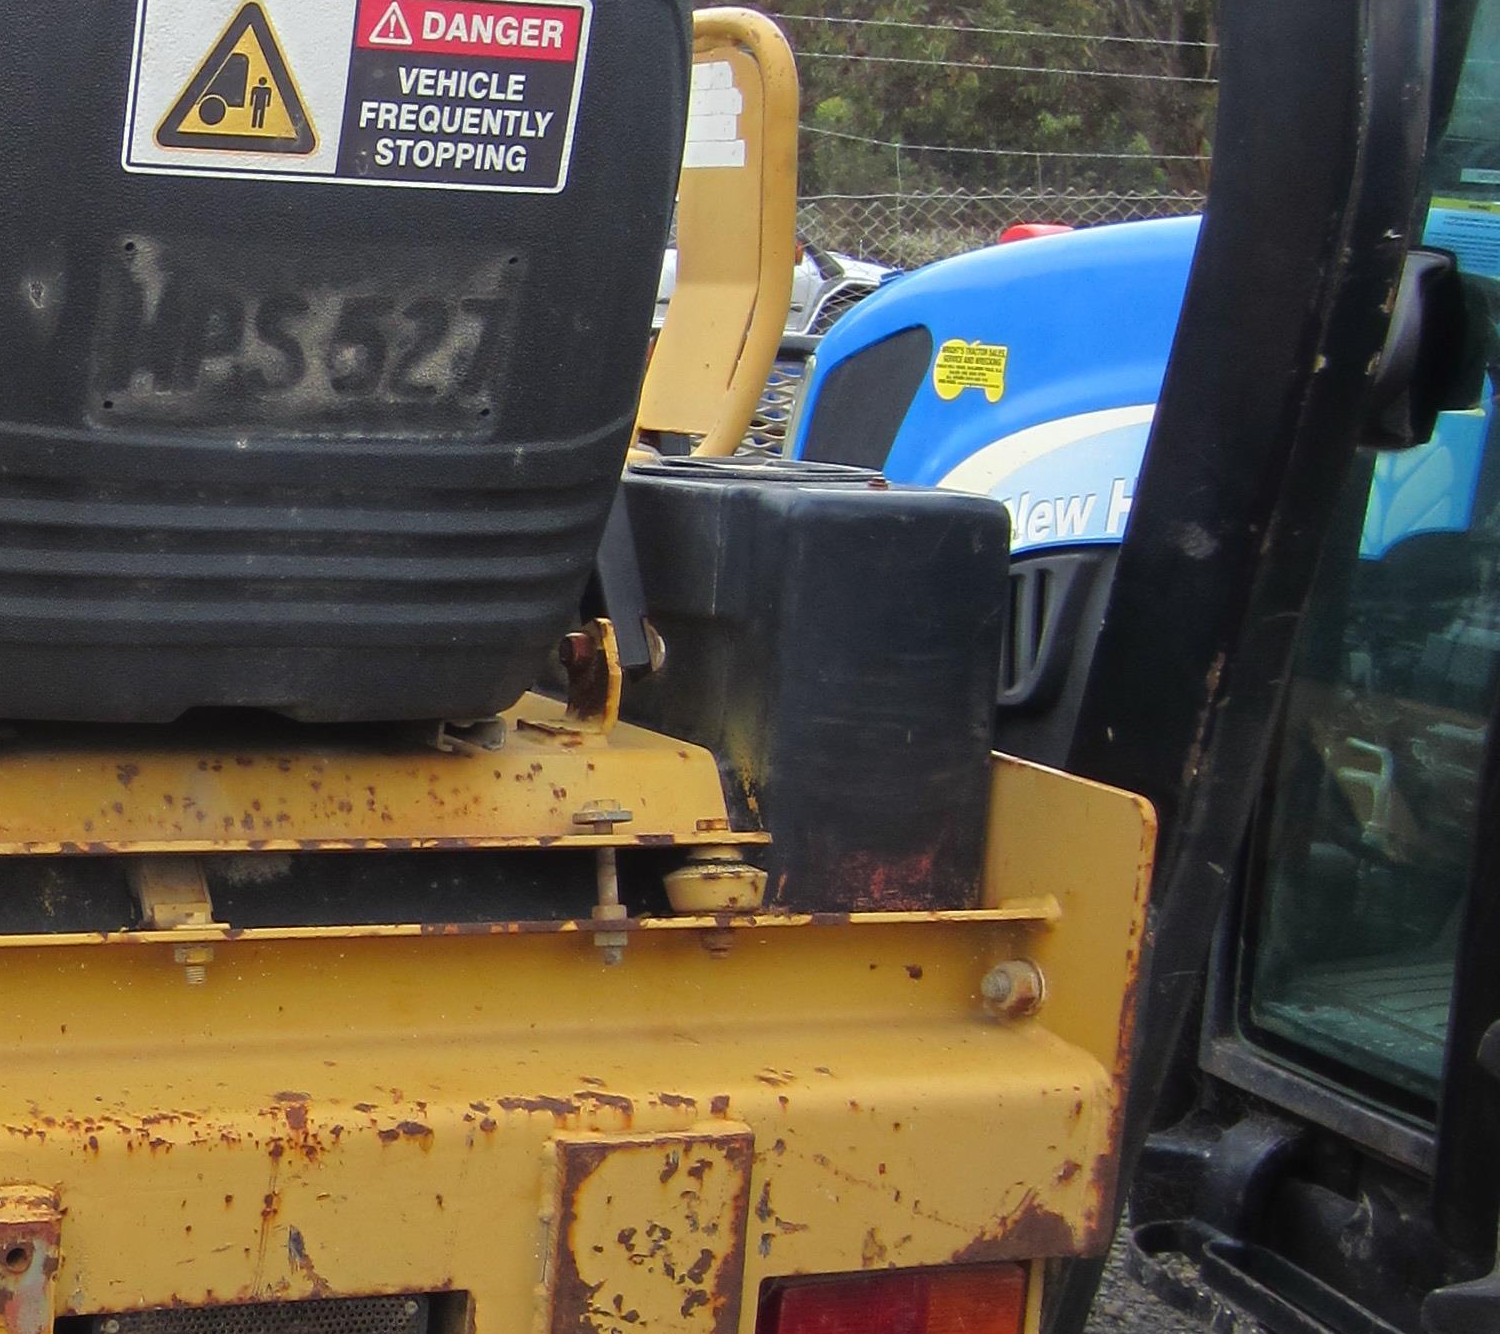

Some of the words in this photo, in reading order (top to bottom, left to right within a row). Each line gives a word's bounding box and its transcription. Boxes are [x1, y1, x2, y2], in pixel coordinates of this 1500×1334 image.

[421, 10, 564, 49] DANGER
[398, 66, 526, 101] VEHICLE
[359, 102, 555, 139] FREQUENTLY
[373, 138, 528, 173] STOPPING
